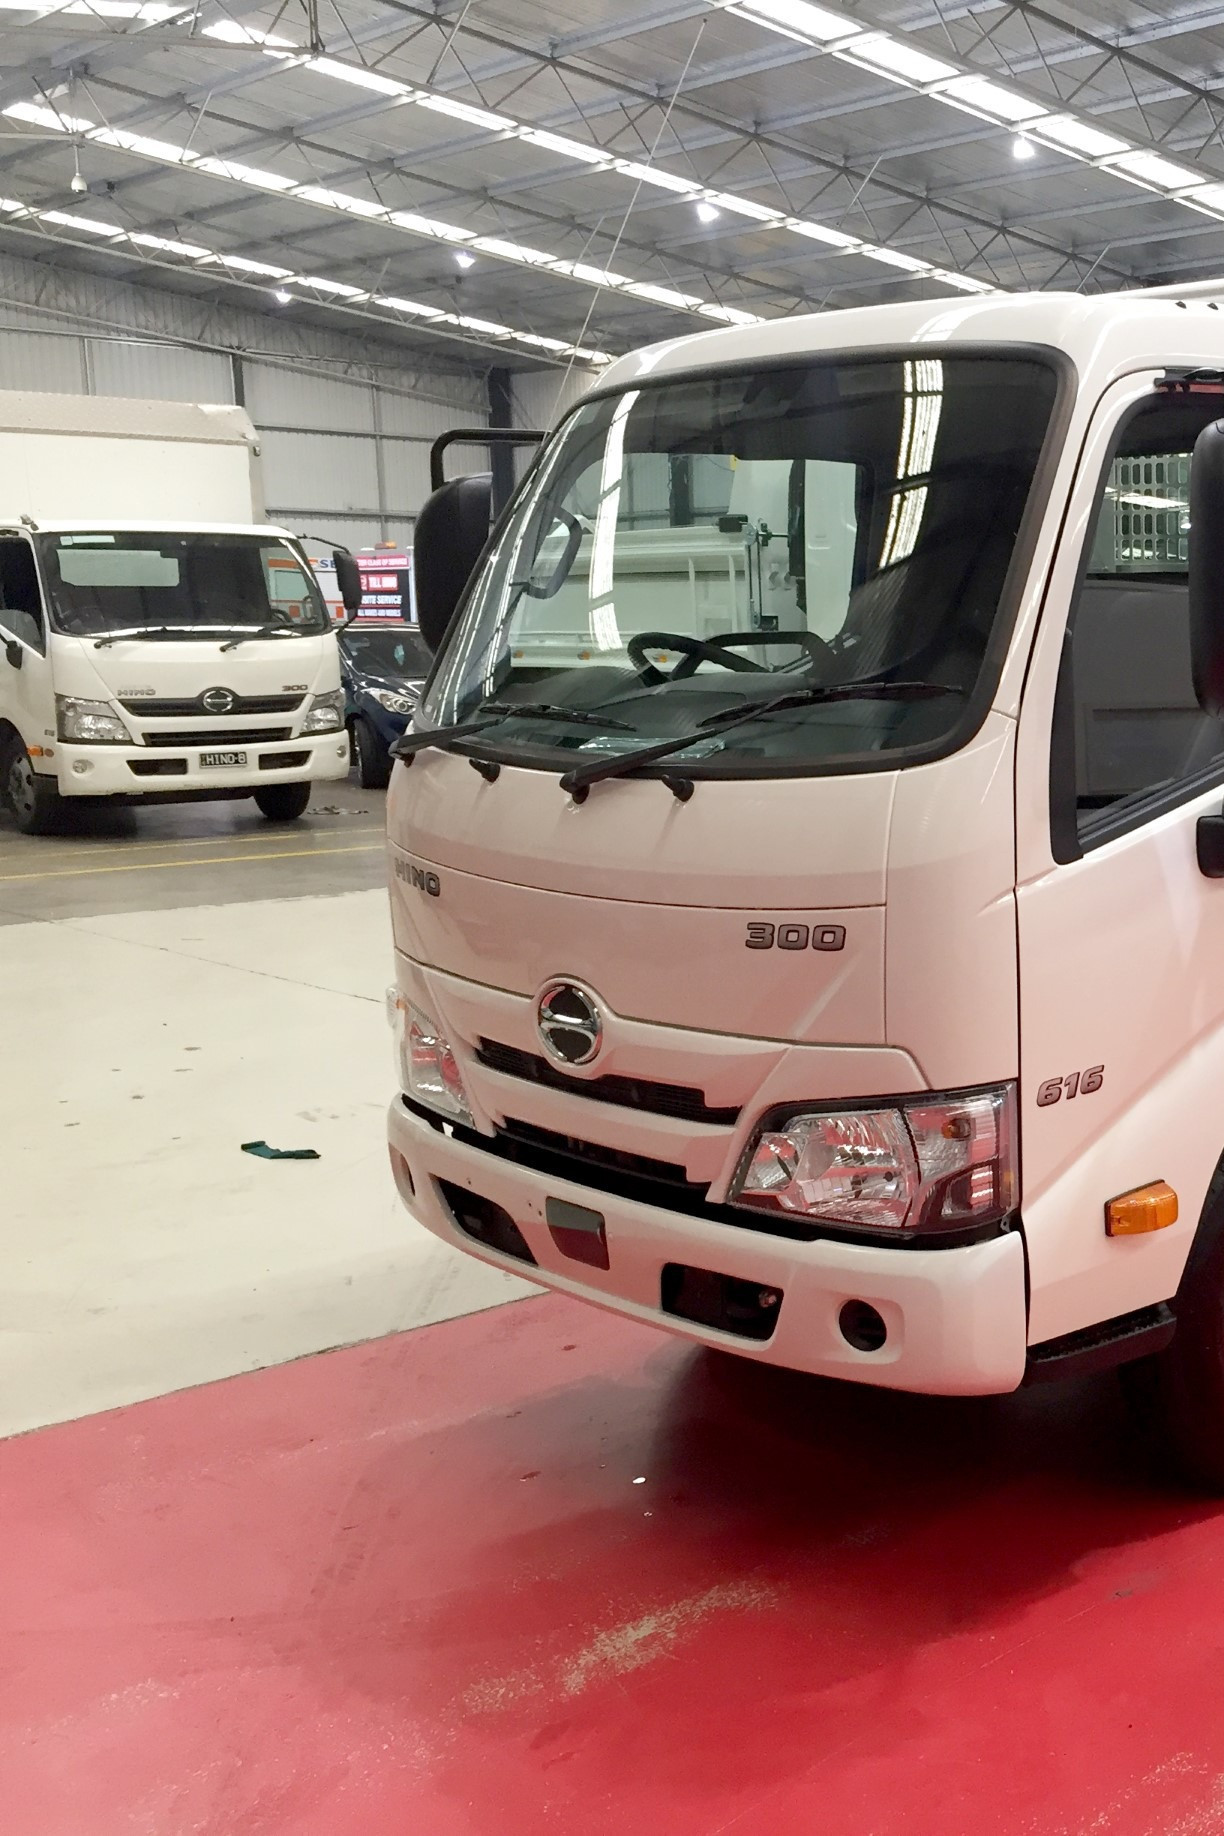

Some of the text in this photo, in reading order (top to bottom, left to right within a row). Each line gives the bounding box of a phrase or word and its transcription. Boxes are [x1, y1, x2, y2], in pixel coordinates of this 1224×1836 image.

[117, 688, 156, 697] HINO
[282, 684, 308, 692] 300
[394, 857, 441, 897] HINO
[745, 922, 847, 952] 300
[1036, 1064, 1105, 1107] 616
